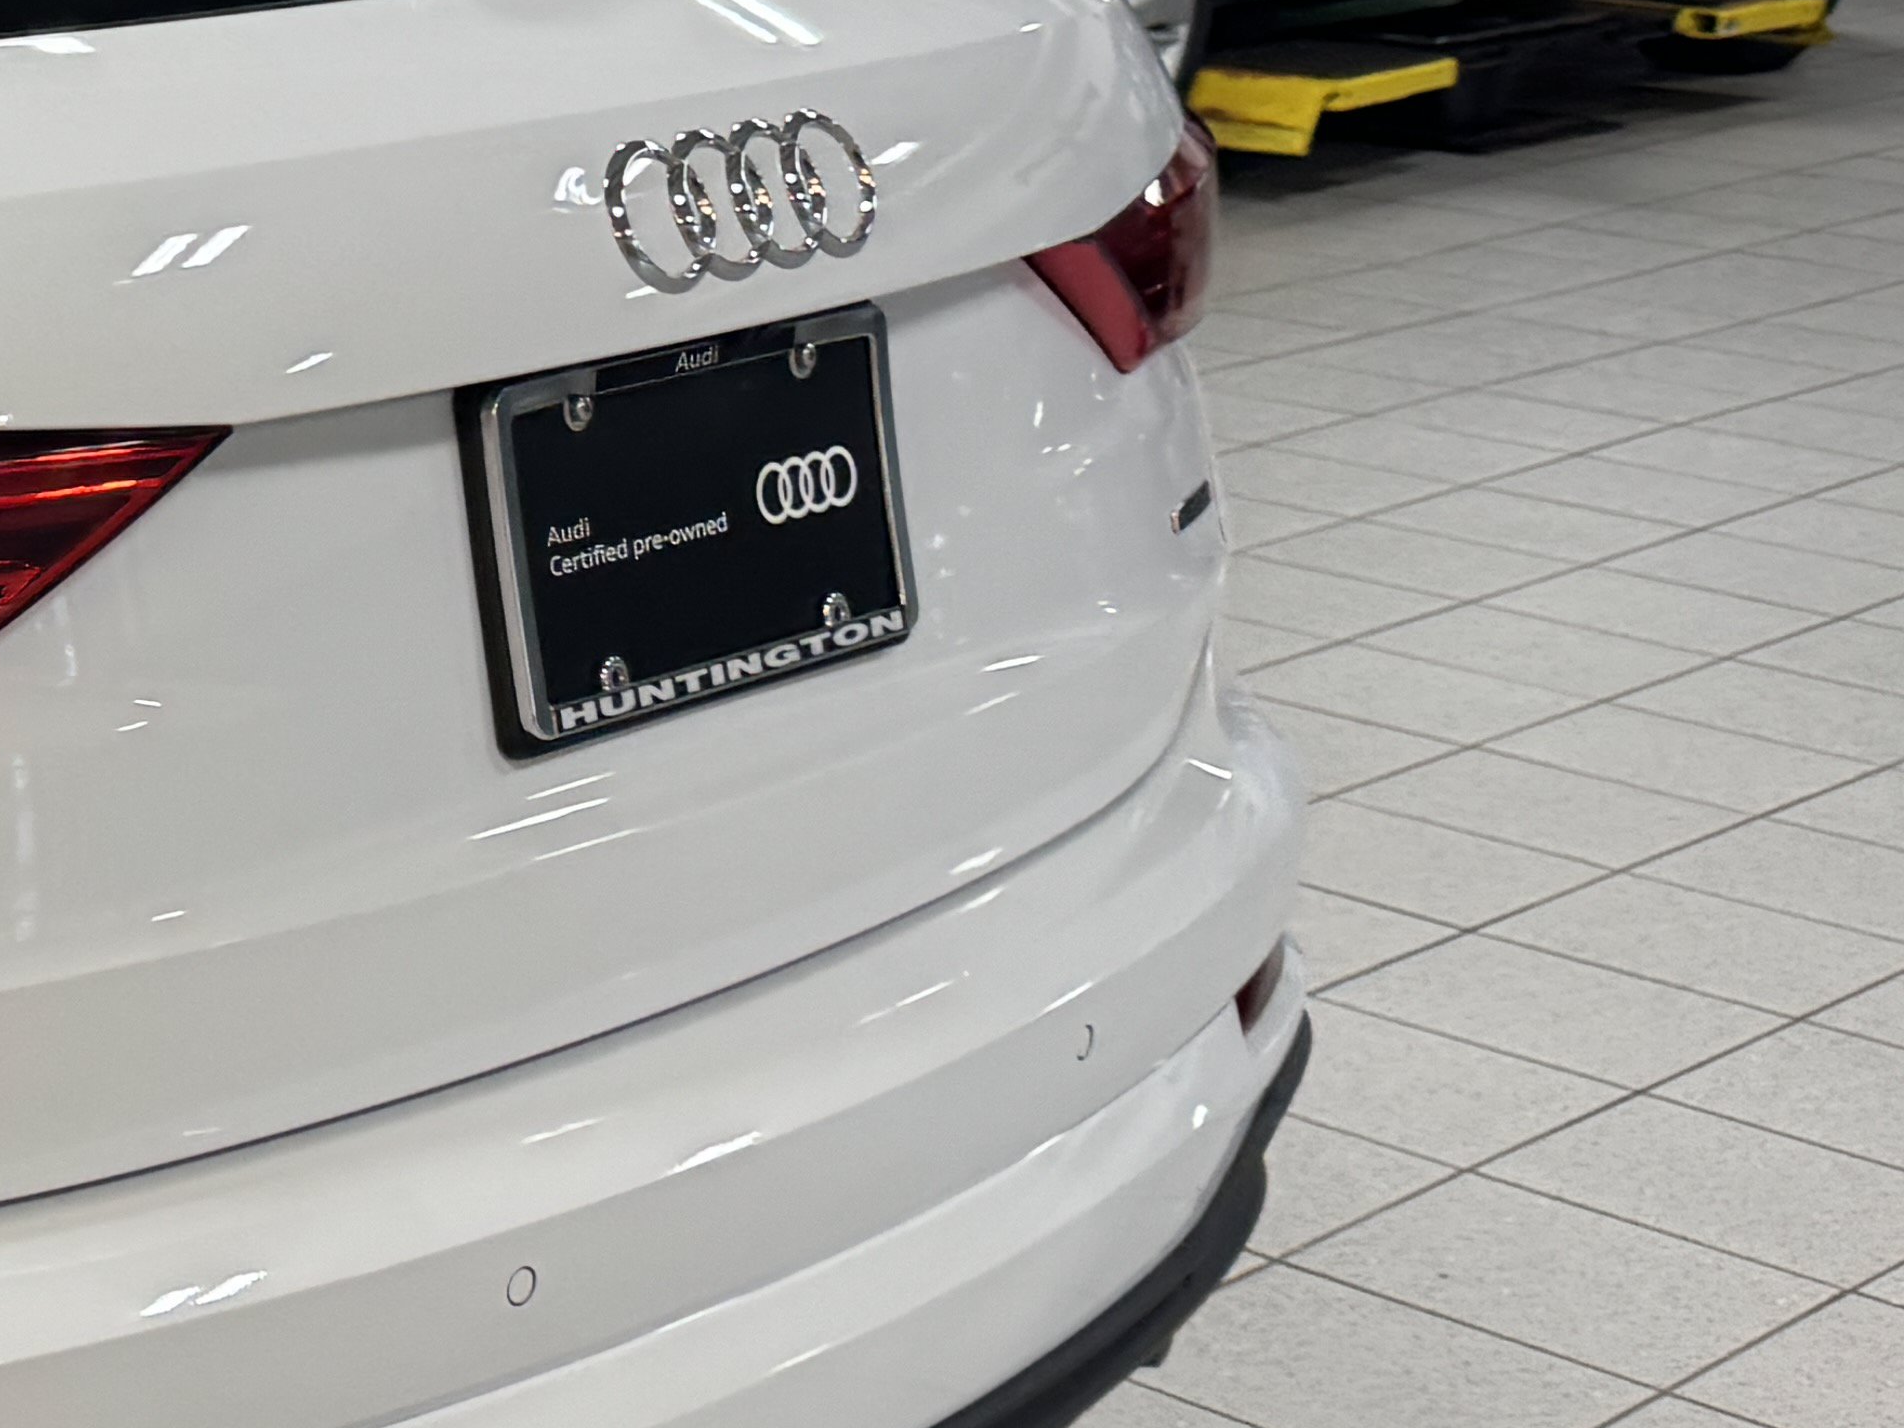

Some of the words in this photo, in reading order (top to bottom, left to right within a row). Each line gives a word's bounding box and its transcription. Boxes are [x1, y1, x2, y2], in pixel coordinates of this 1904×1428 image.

[675, 345, 721, 373] Audi
[546, 516, 592, 547] Audi
[549, 538, 629, 577] Certified
[633, 510, 730, 560] pre-owned
[559, 610, 905, 730] HUNTINGTON
